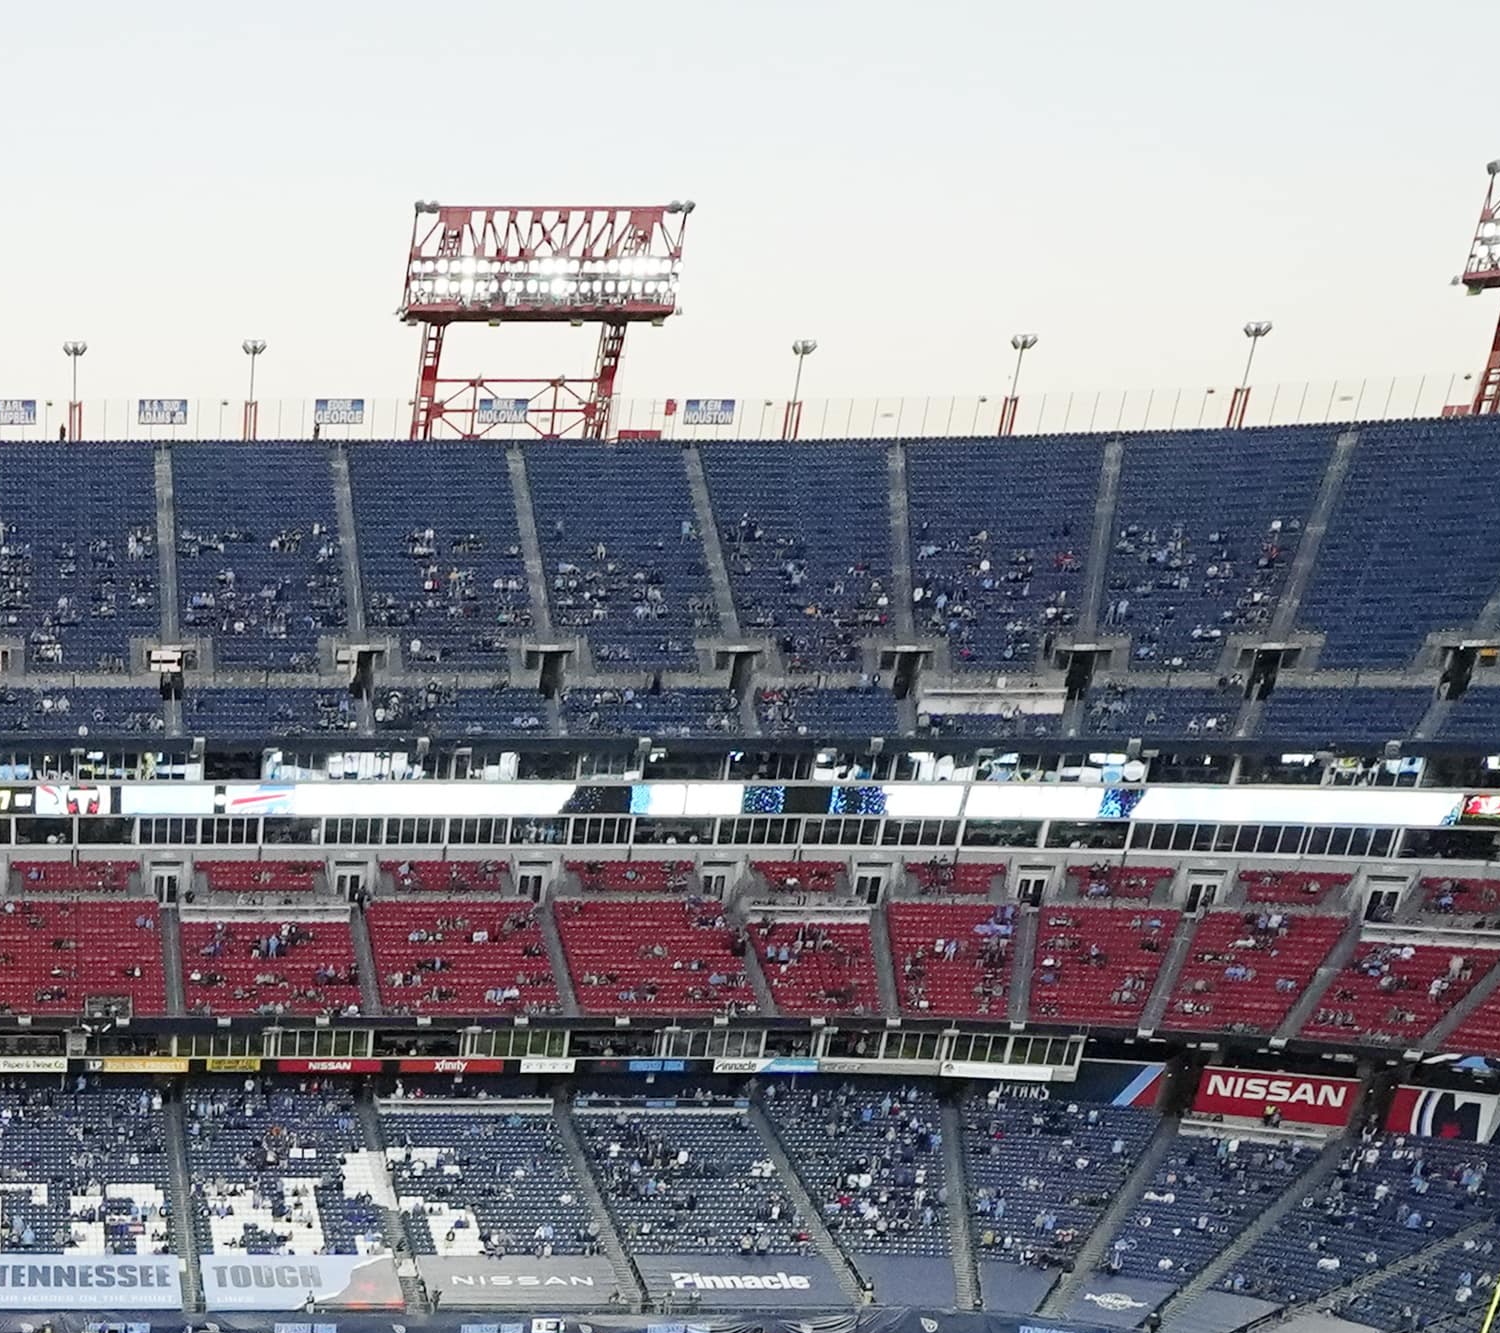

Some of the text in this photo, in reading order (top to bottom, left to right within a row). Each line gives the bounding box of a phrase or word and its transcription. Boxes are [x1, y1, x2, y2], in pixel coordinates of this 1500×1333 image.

[308, 1061, 352, 1071] NISSAN
[433, 1059, 468, 1073] xfinity
[1206, 1074, 1349, 1107] NISSAN
[212, 1264, 323, 1289] TOUGH
[449, 1274, 594, 1287] NISSAN
[669, 1272, 811, 1291] Pinnacle
